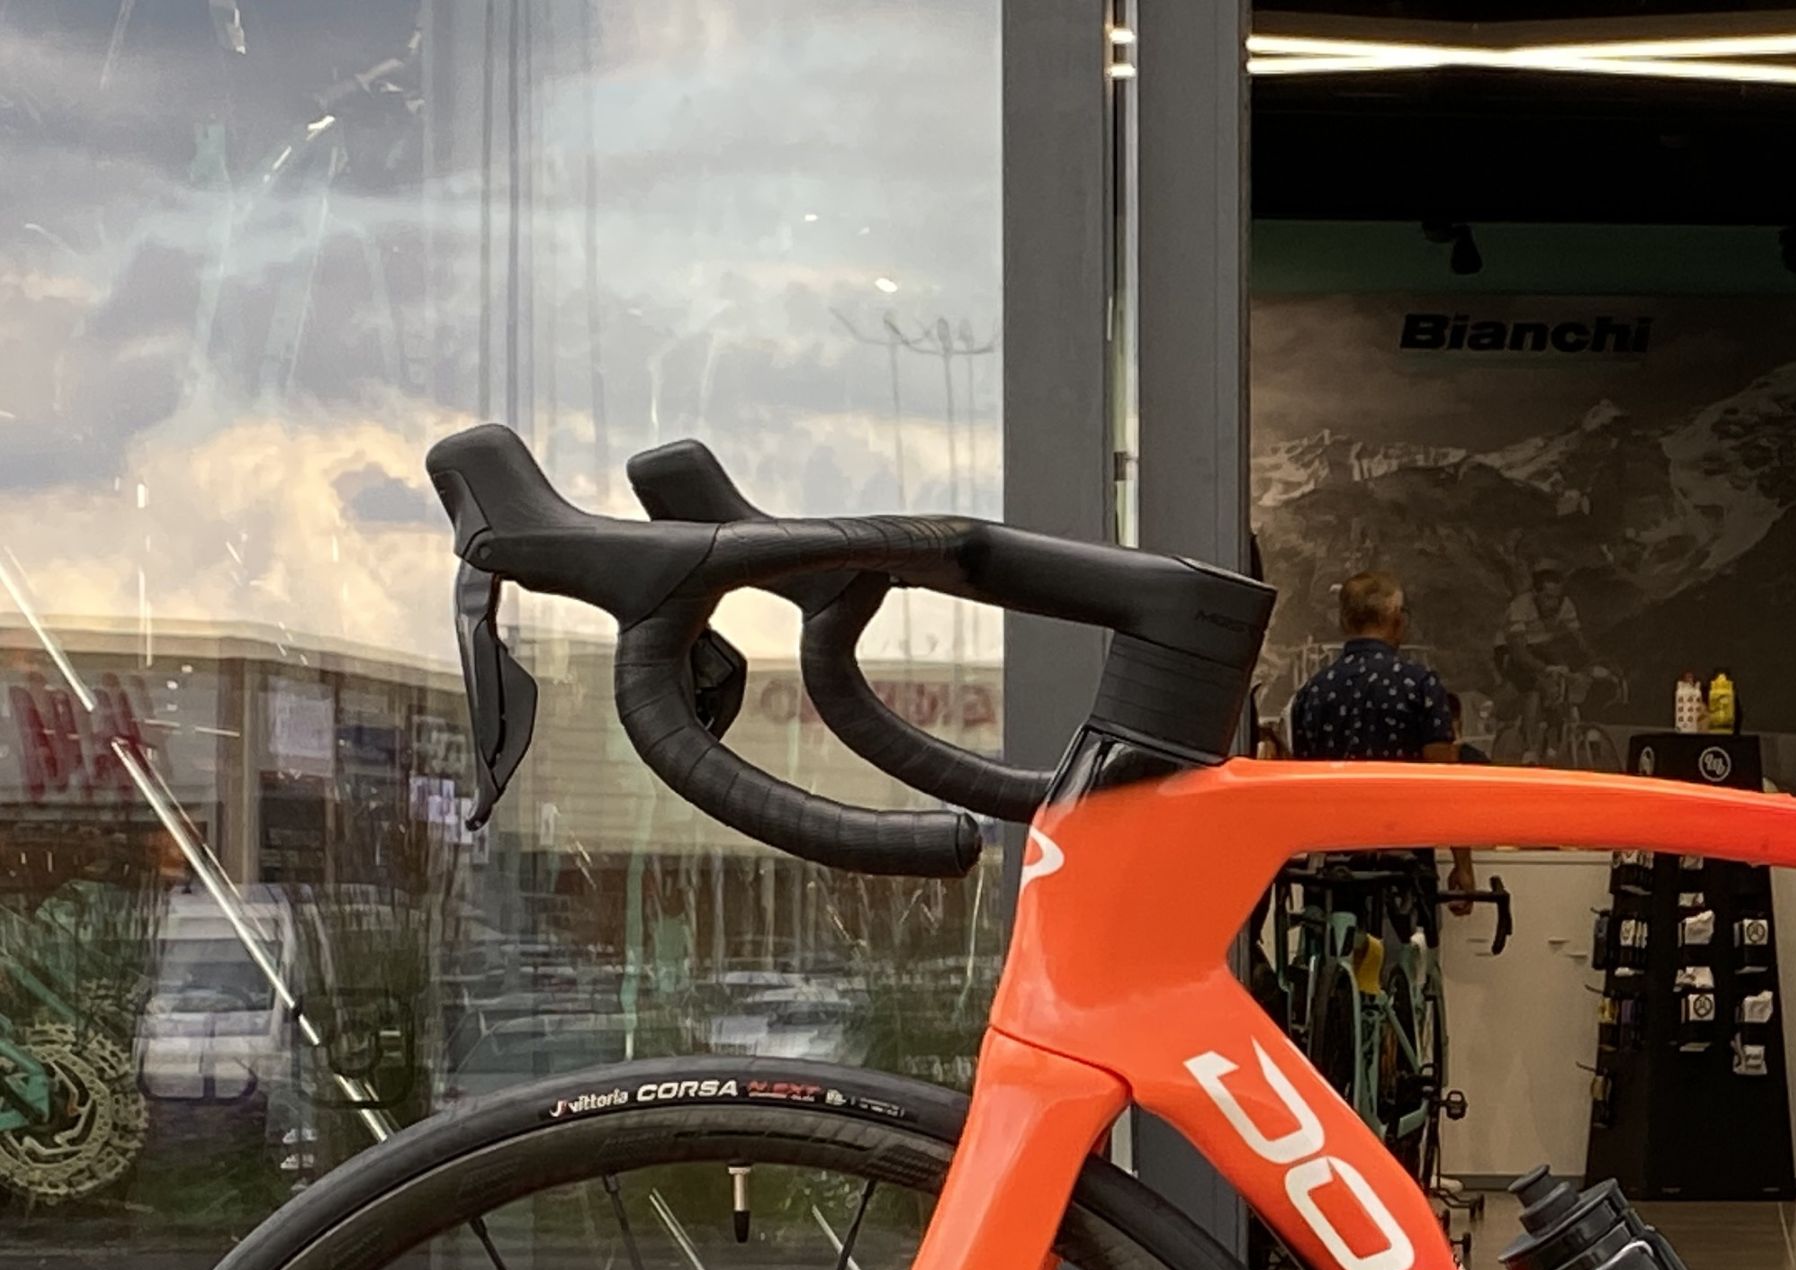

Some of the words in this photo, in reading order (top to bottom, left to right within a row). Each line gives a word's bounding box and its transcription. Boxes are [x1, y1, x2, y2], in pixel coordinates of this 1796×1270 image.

[1399, 311, 1654, 354] Bianchi
[568, 1088, 629, 1114] vittoria
[636, 1079, 739, 1102] CORSA
